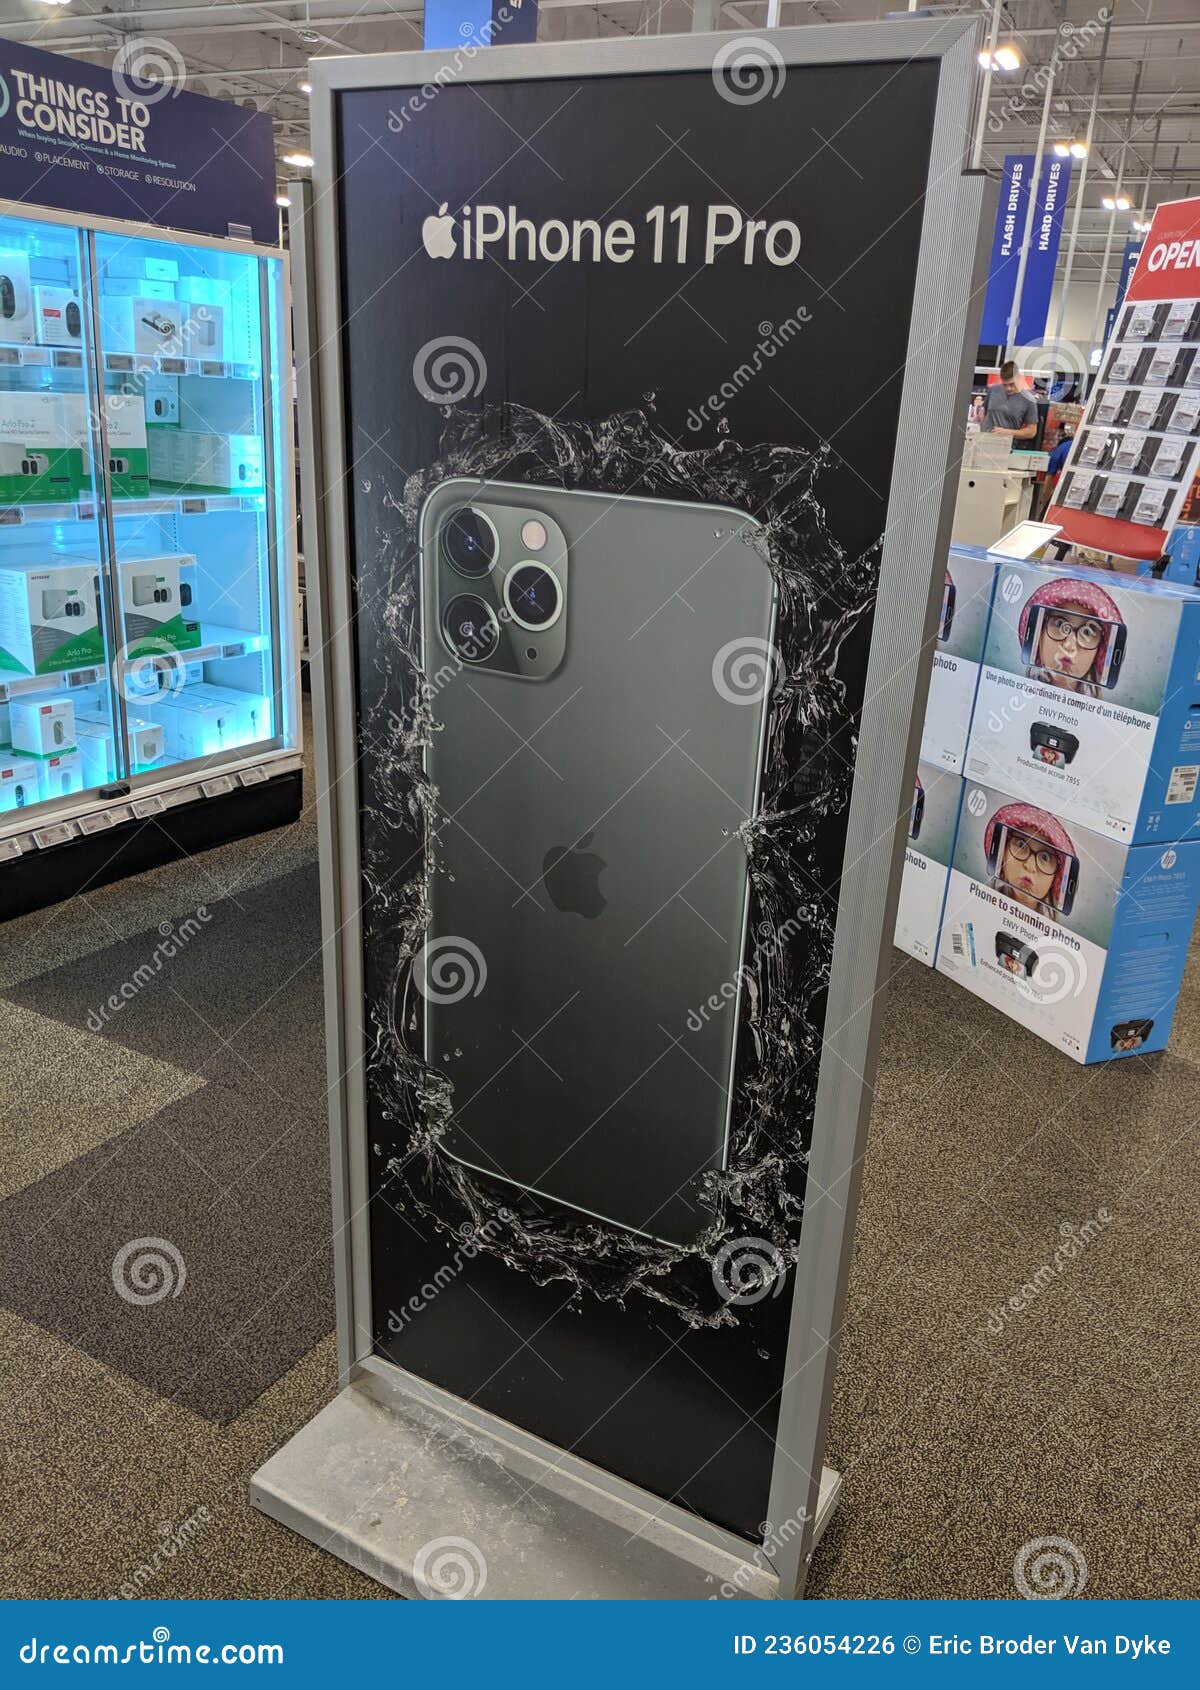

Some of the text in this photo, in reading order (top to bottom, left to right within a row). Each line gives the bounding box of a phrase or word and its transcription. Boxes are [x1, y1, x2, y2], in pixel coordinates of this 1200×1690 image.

[10, 69, 150, 128] THINGS TO
[16, 101, 147, 152] CONSIDER
[18, 129, 36, 138] When
[36, 133, 57, 145] buying
[0, 144, 28, 158] AUDIO
[42, 153, 90, 171] PLACEMENT
[104, 167, 140, 181] STORAGE
[152, 175, 196, 192] RESOLUTION
[1001, 163, 1024, 256] FLASH DRIVES
[1038, 163, 1061, 251] HARD DRIVES
[462, 205, 802, 267] iPhone 11 Pro
[1147, 239, 1200, 272] OPEN
[1003, 574, 1022, 603] hp
[933, 656, 958, 672] photo
[986, 671, 997, 681] Une
[997, 674, 1016, 688] photo
[1067, 697, 1096, 712] compter
[1096, 705, 1113, 718] d'un
[1113, 709, 1152, 730] téléphone
[1038, 705, 1079, 726] ENVY Photo
[968, 789, 987, 816] hp
[969, 882, 1081, 952] Phone to stunning photo
[1002, 917, 1039, 943] ENVY Photo
